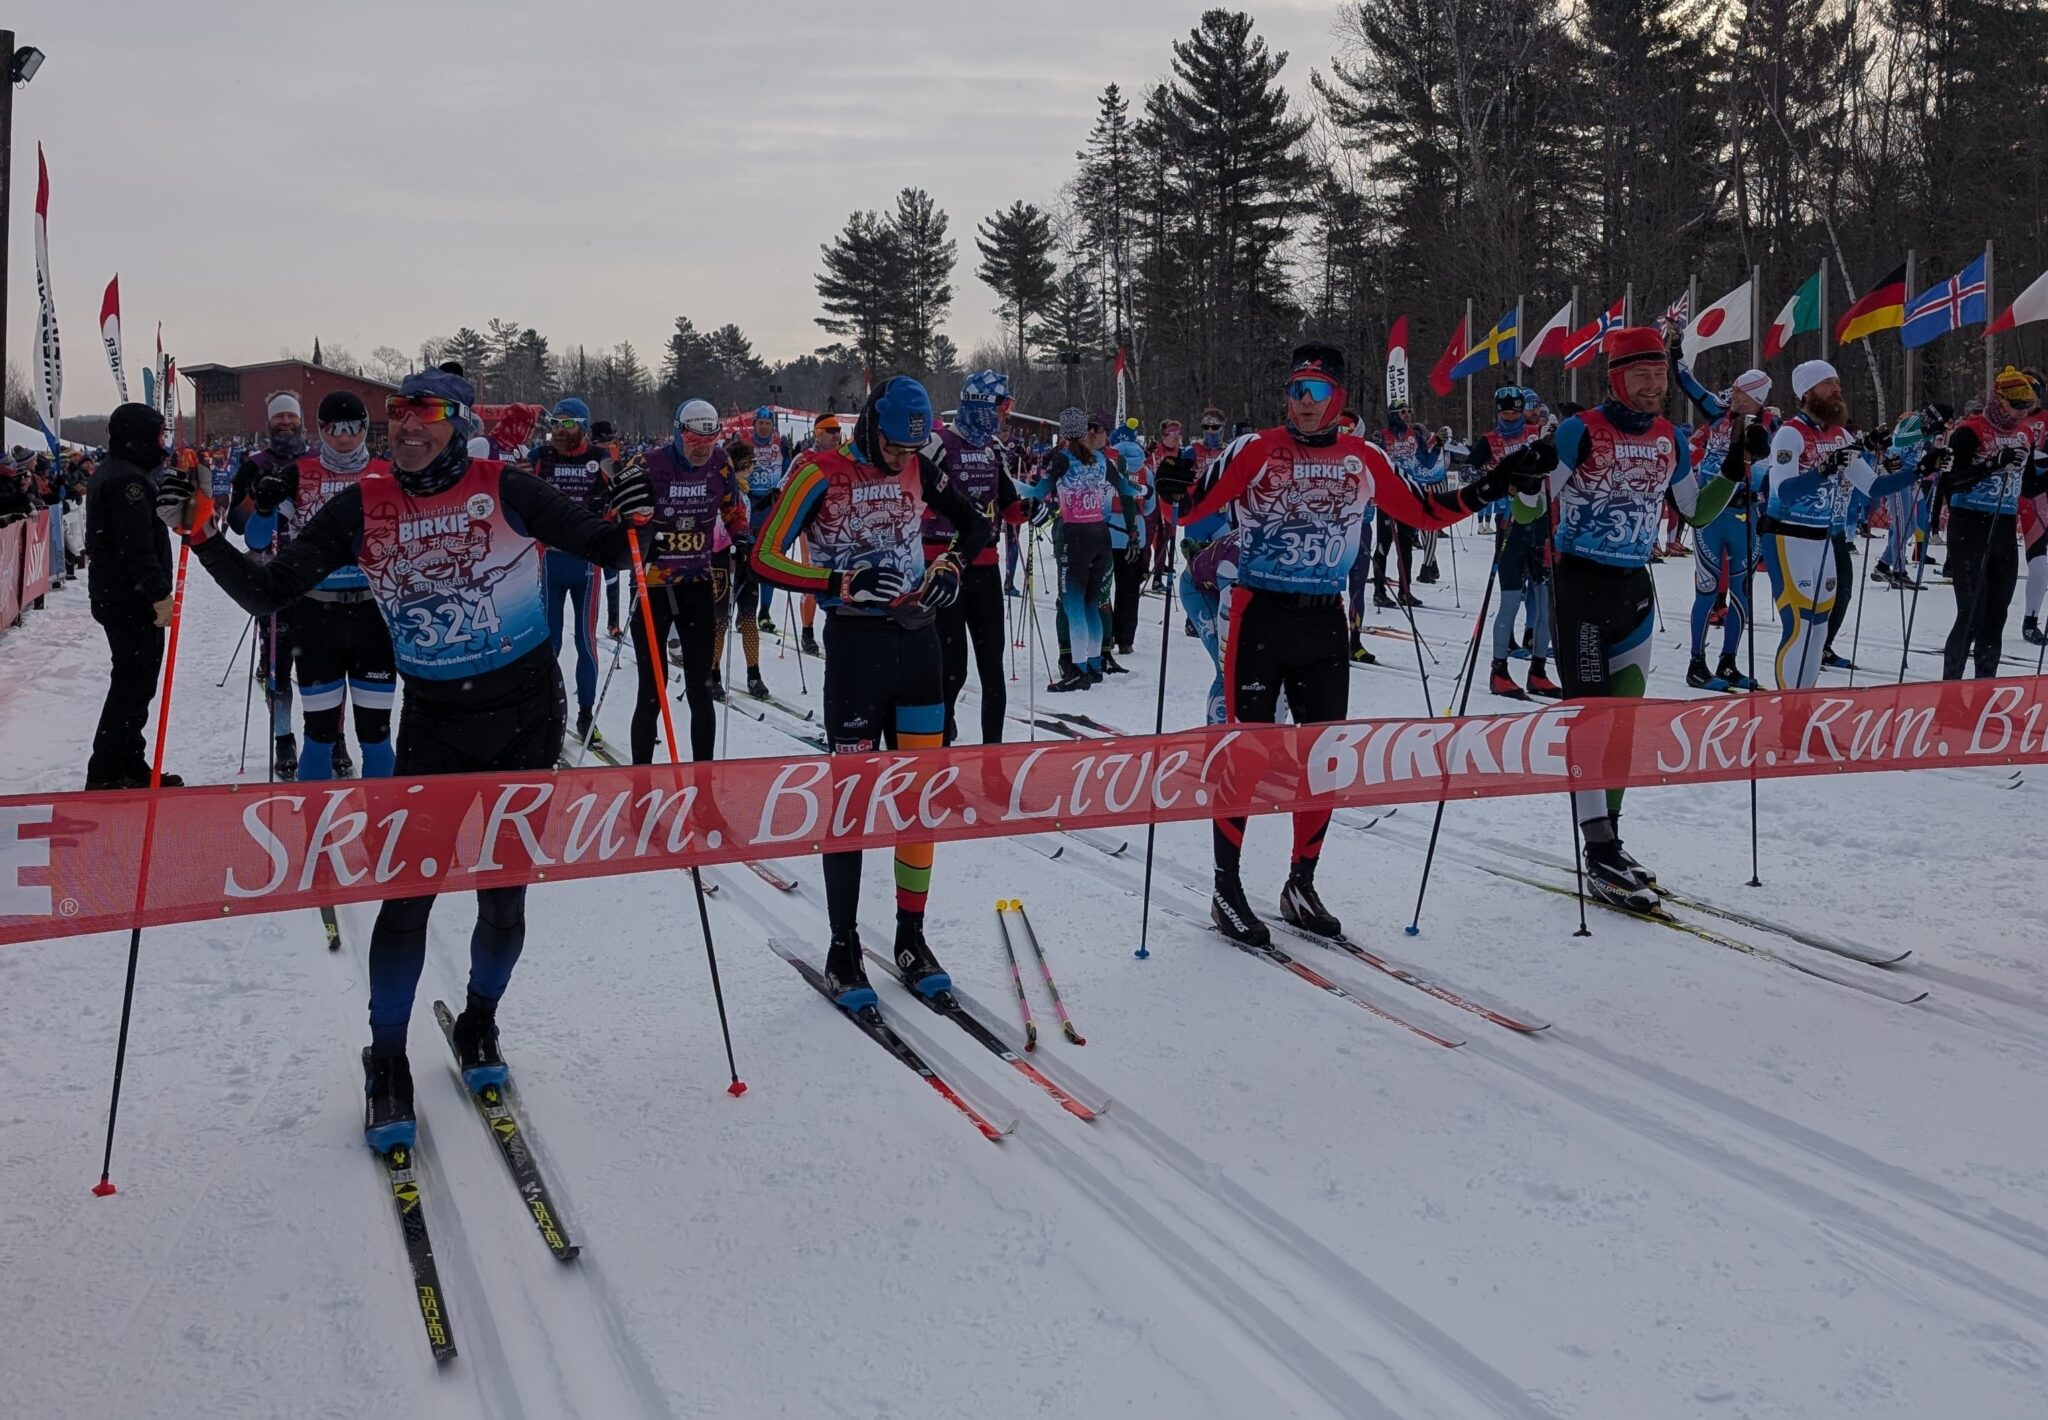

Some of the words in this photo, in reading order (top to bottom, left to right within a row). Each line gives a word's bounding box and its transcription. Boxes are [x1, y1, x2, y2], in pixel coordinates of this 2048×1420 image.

[1615, 445, 1658, 461] BIRKIE
[554, 468, 587, 477] BIRKIE
[1293, 464, 1346, 480] BIRKIE
[669, 485, 707, 498] BIRKIE
[852, 484, 903, 504] BIRKIE
[398, 502, 467, 521] slumberland
[477, 504, 485, 516] 9
[399, 513, 470, 543] BIRKIE
[1606, 509, 1655, 545] 379
[416, 552, 481, 568] ARIENS
[1278, 532, 1346, 568] 350
[413, 582, 433, 592] BEN
[433, 576, 470, 590] HUSABY
[406, 594, 502, 648] 324
[1578, 622, 1591, 658] NORDIC
[1588, 623, 1602, 683] MANSFIELD
[1579, 658, 1591, 683] CLUB
[1308, 705, 1581, 796] BIRKIE
[1656, 696, 1777, 774] Ski.
[1794, 698, 1949, 764] Run.
[223, 785, 438, 898] Ski.
[468, 783, 723, 874] Run.
[749, 756, 977, 845] Bike.
[1000, 731, 1240, 822] Live!
[1213, 888, 1250, 933] MADSHUS
[529, 1200, 565, 1250] FISCHER
[418, 1285, 447, 1346] FISCHER
